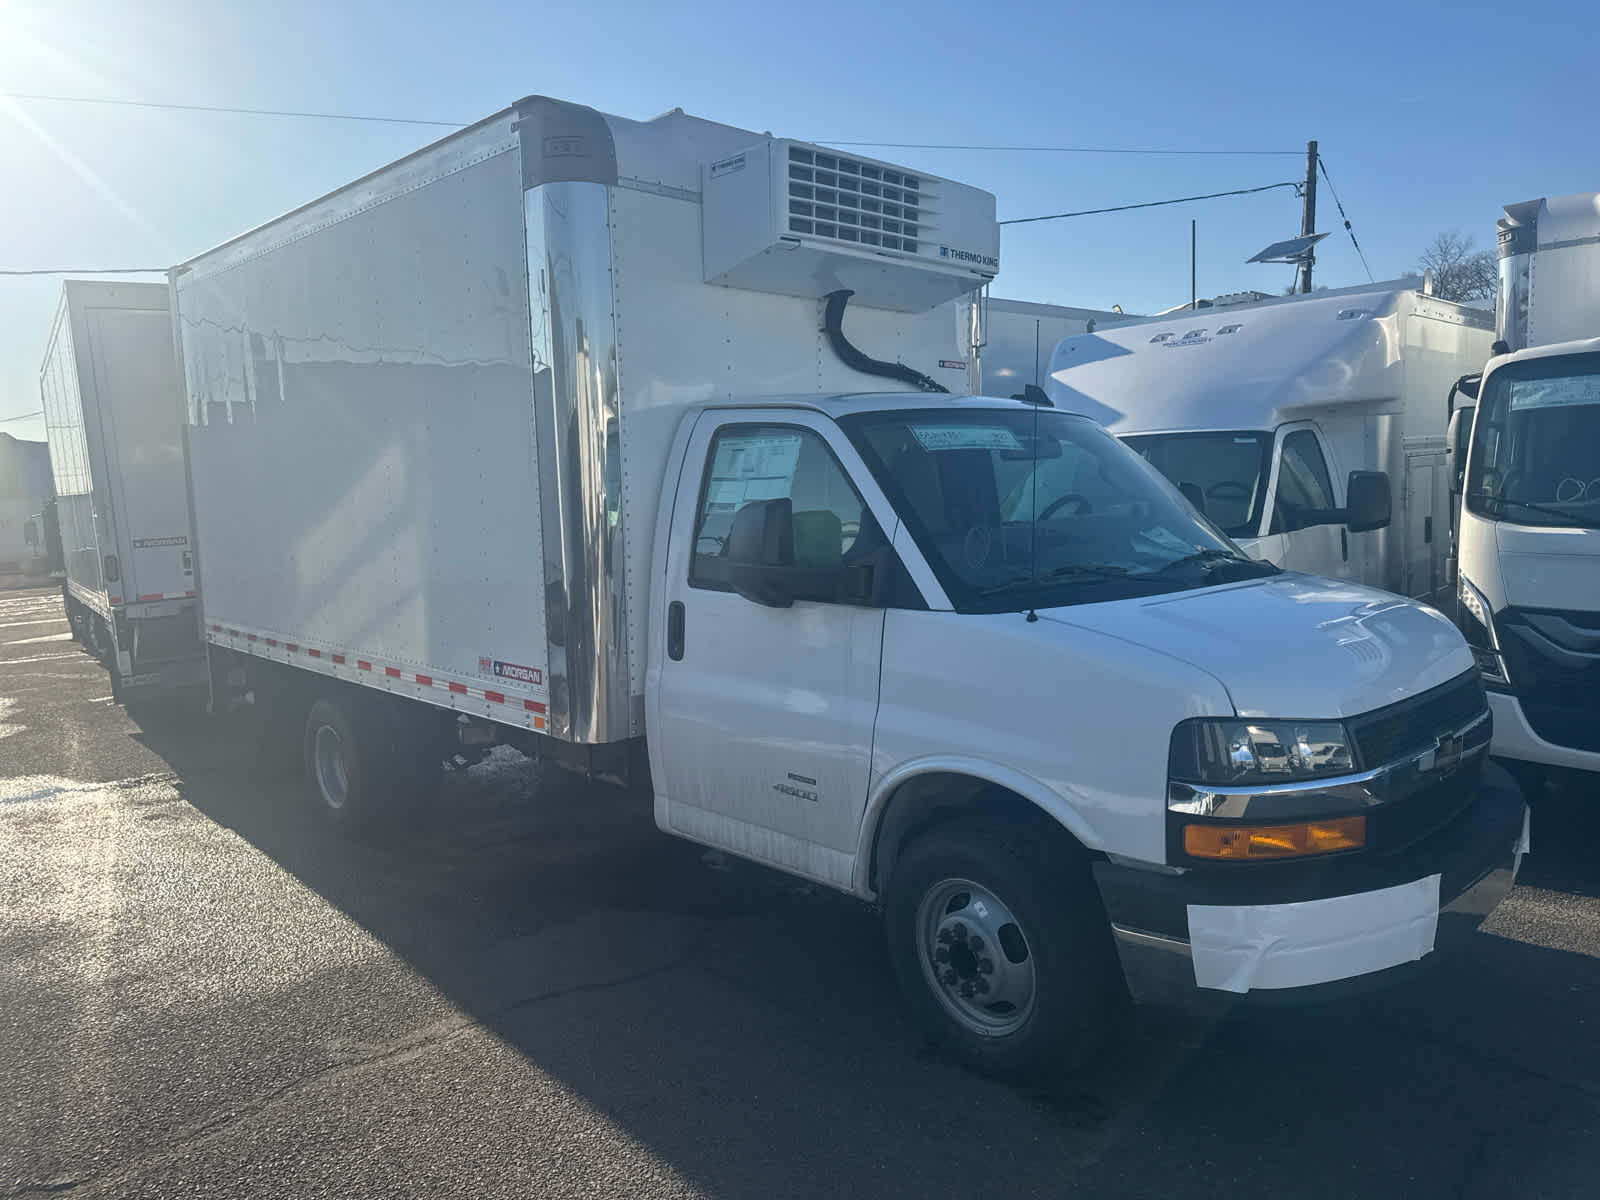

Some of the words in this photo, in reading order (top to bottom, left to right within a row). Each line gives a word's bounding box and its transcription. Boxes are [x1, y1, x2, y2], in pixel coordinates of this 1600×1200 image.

[950, 249, 982, 265] THERMO
[982, 256, 998, 268] KING
[502, 664, 540, 683] MORGAN
